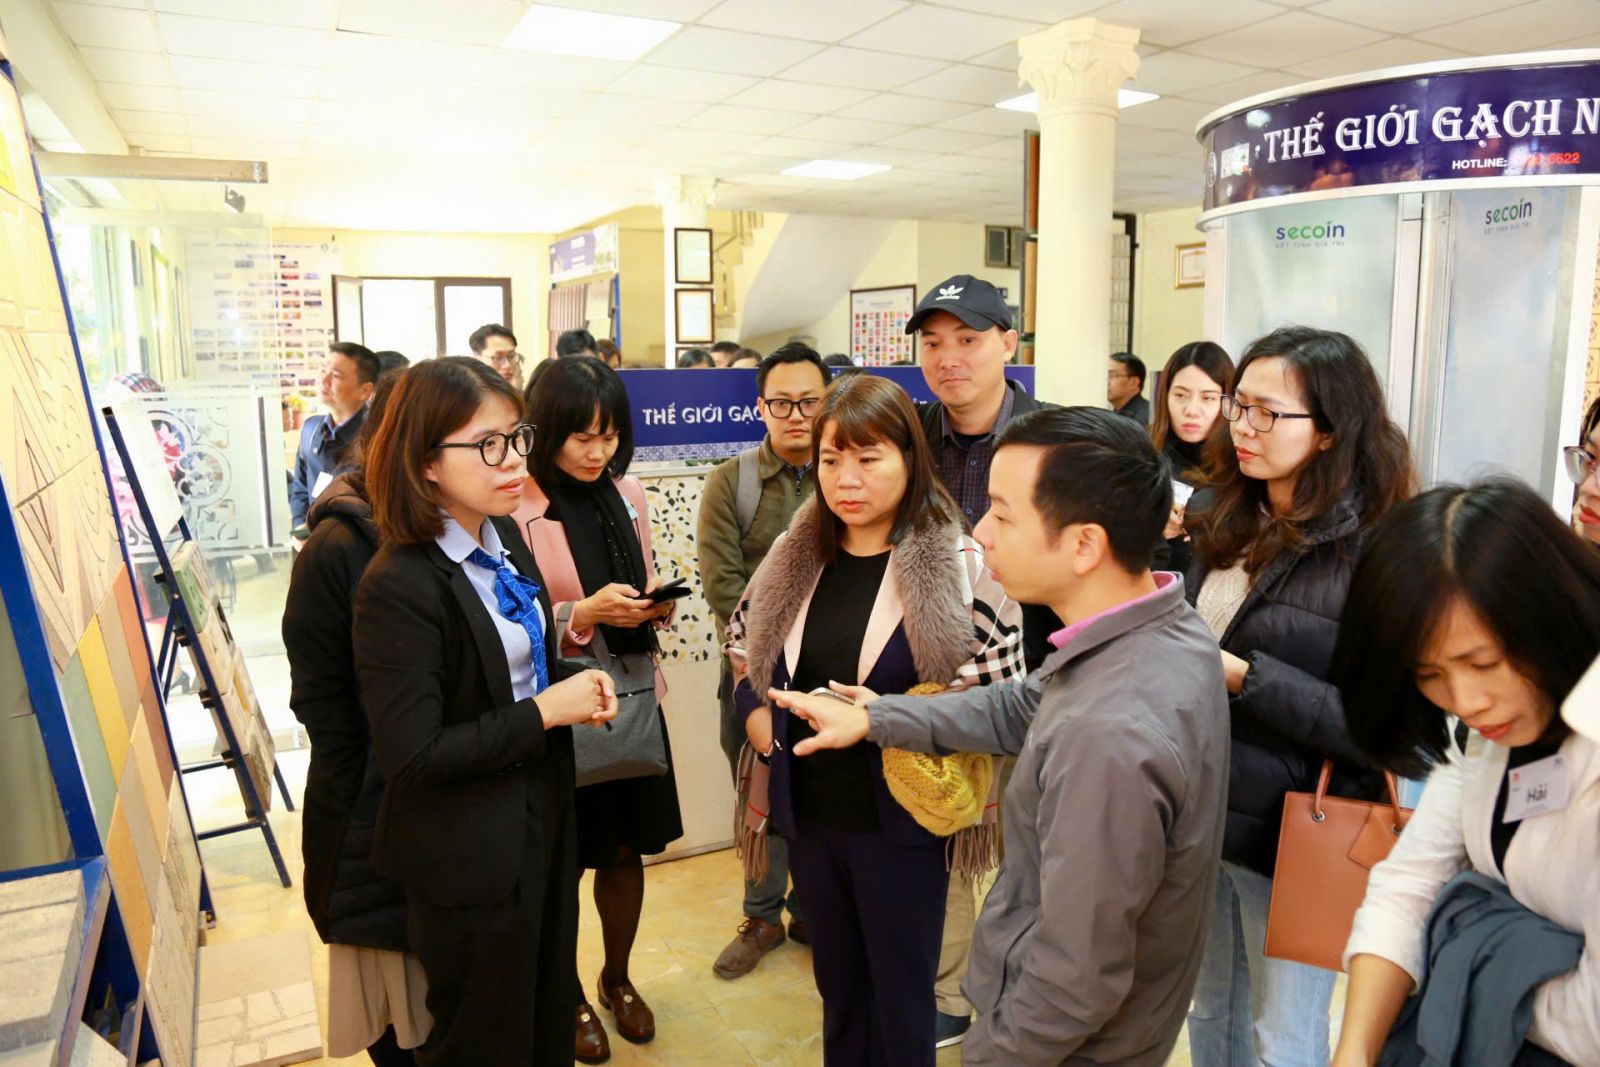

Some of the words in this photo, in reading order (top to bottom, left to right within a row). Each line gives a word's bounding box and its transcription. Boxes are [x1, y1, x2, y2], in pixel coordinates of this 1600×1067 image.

[1263, 111, 1326, 164] THẾ
[1335, 104, 1420, 151] GIỚI
[1431, 99, 1562, 148] GẠCH
[1452, 157, 1508, 170] HOTLINE:
[642, 402, 676, 425] THẾ
[681, 403, 722, 424] GIỚI
[728, 405, 763, 424] GẠC
